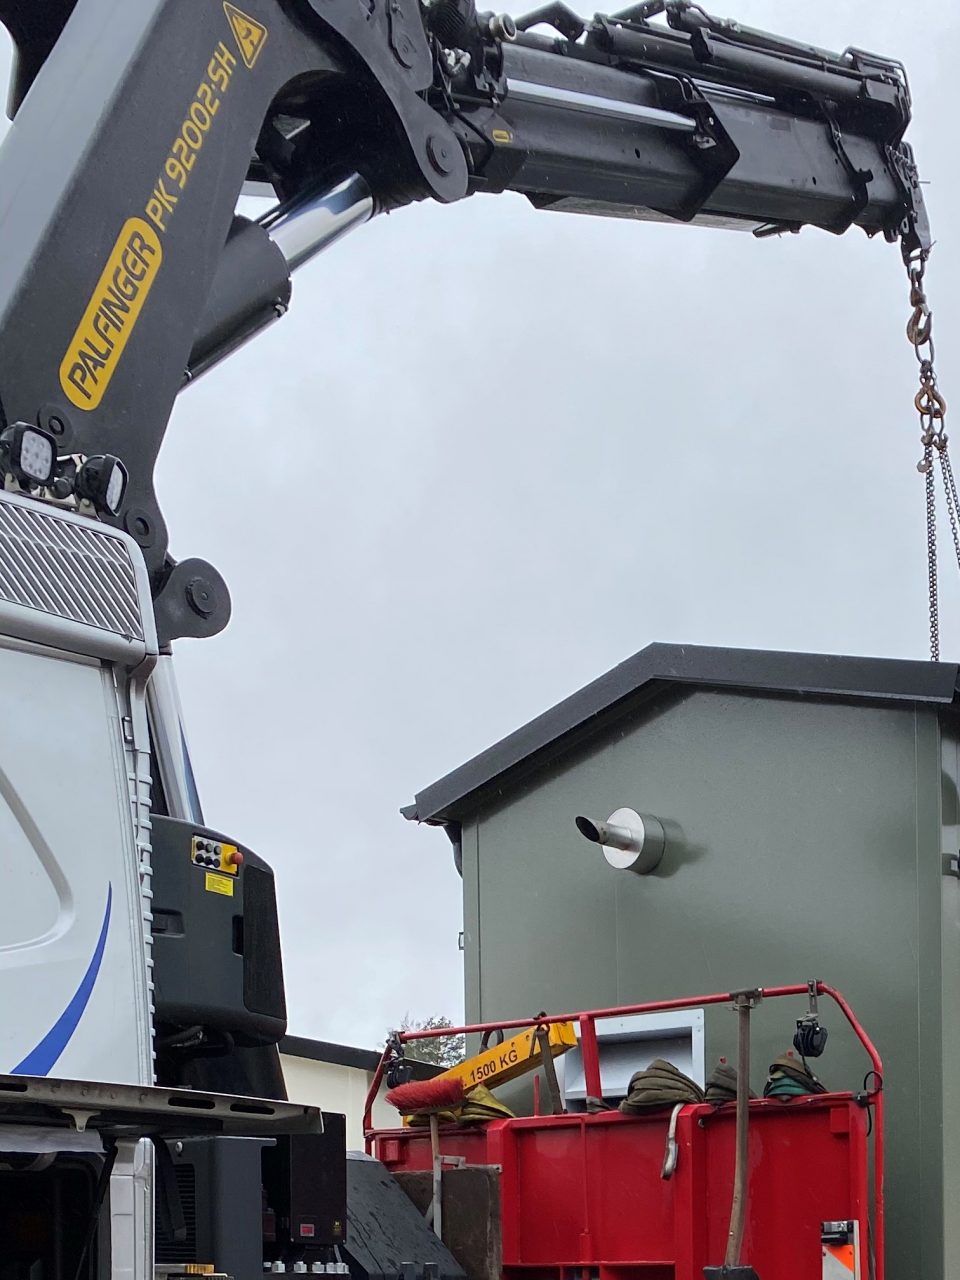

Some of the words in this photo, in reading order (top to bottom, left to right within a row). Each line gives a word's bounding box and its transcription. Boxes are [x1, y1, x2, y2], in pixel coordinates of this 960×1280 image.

[145, 178, 177, 233] PK
[67, 230, 156, 400] PALFINGER
[470, 1060, 497, 1082] 1500
[499, 1049, 518, 1068] KG
